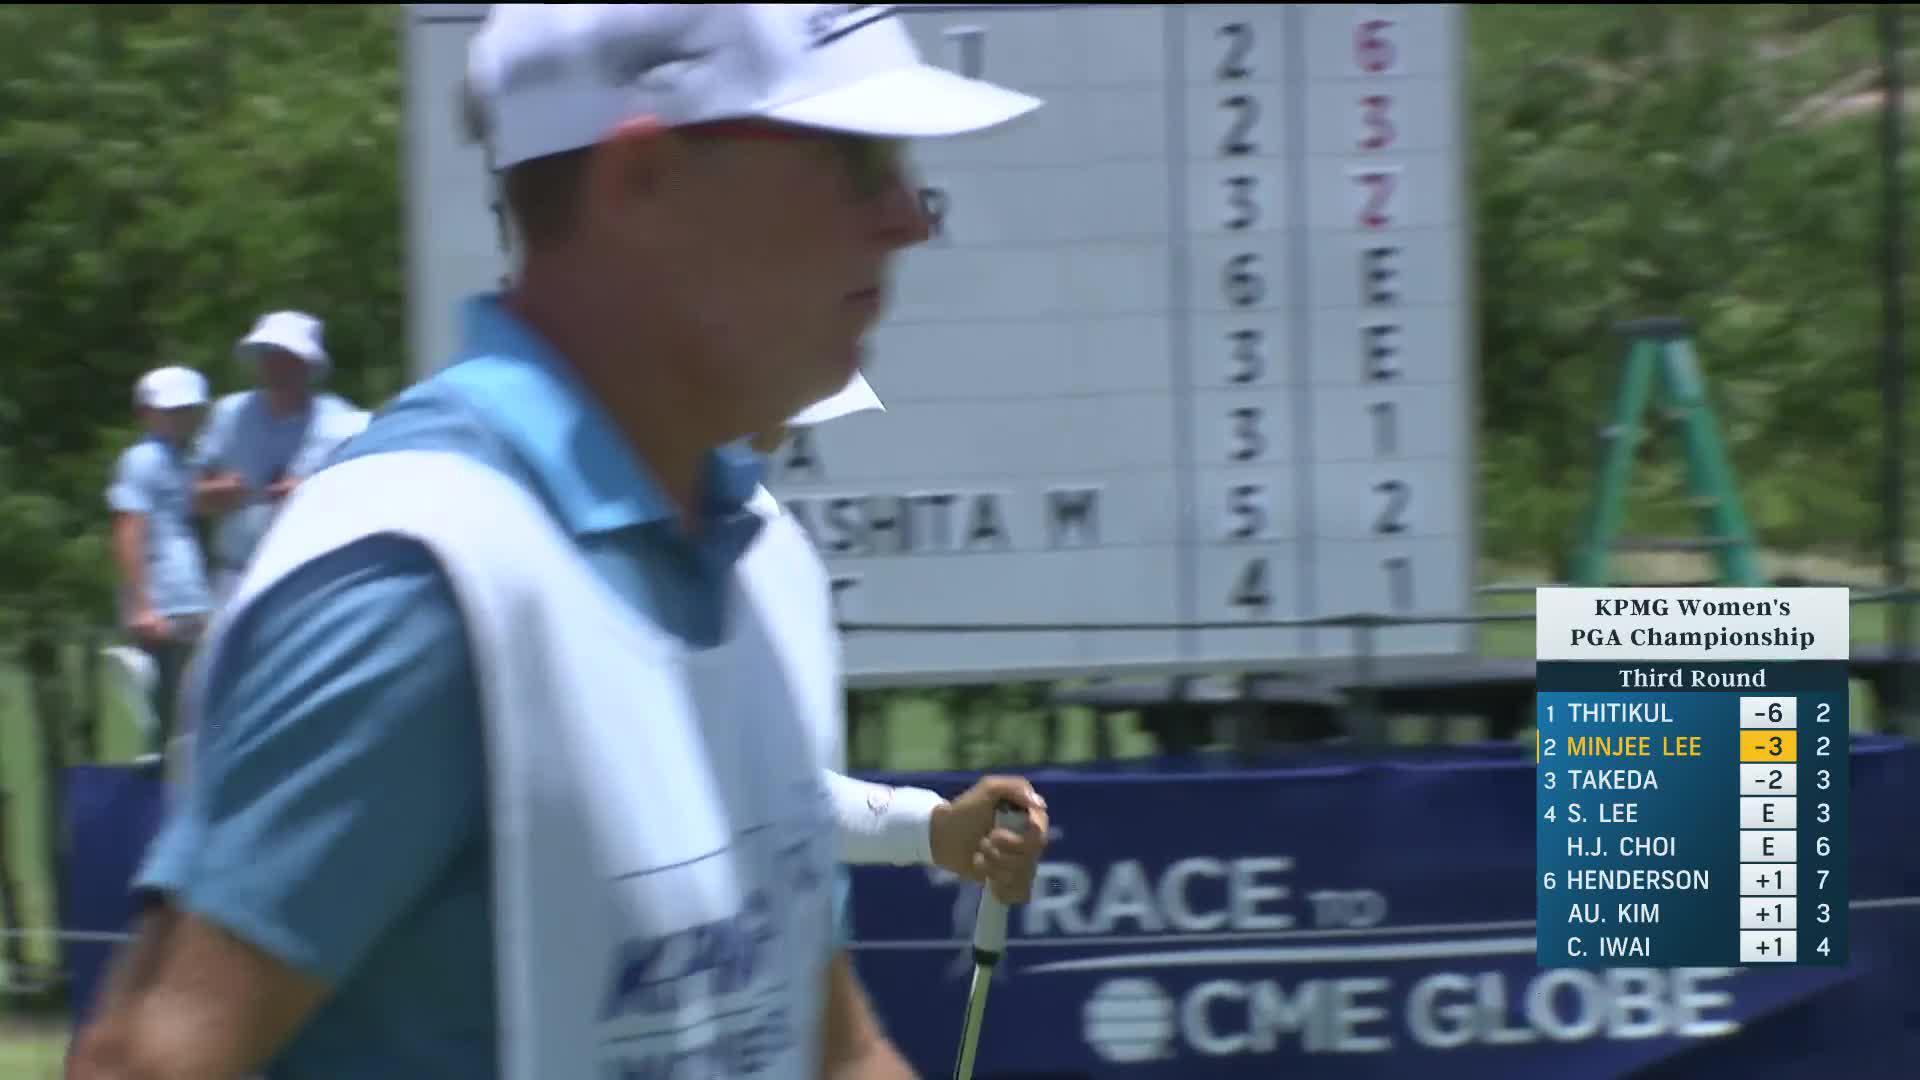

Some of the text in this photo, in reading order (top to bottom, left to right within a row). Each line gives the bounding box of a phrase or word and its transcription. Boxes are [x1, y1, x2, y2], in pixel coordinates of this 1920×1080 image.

[1216, 23, 1256, 79] 2
[1353, 19, 1397, 72] 6
[1218, 95, 1397, 156] 2 3
[1222, 176, 1260, 230] 3
[1222, 246, 1402, 306] 6 E
[1223, 324, 1403, 384] 3 E
[1225, 406, 1266, 461] 3
[1367, 401, 1397, 454] 1
[1226, 484, 1268, 540] 5
[1371, 480, 1412, 535] 2
[1226, 557, 1273, 613] 4
[1380, 557, 1415, 609] 1
[1021, 856, 1388, 936] RACE TO
[1180, 966, 1750, 1056] CME GLOBE
